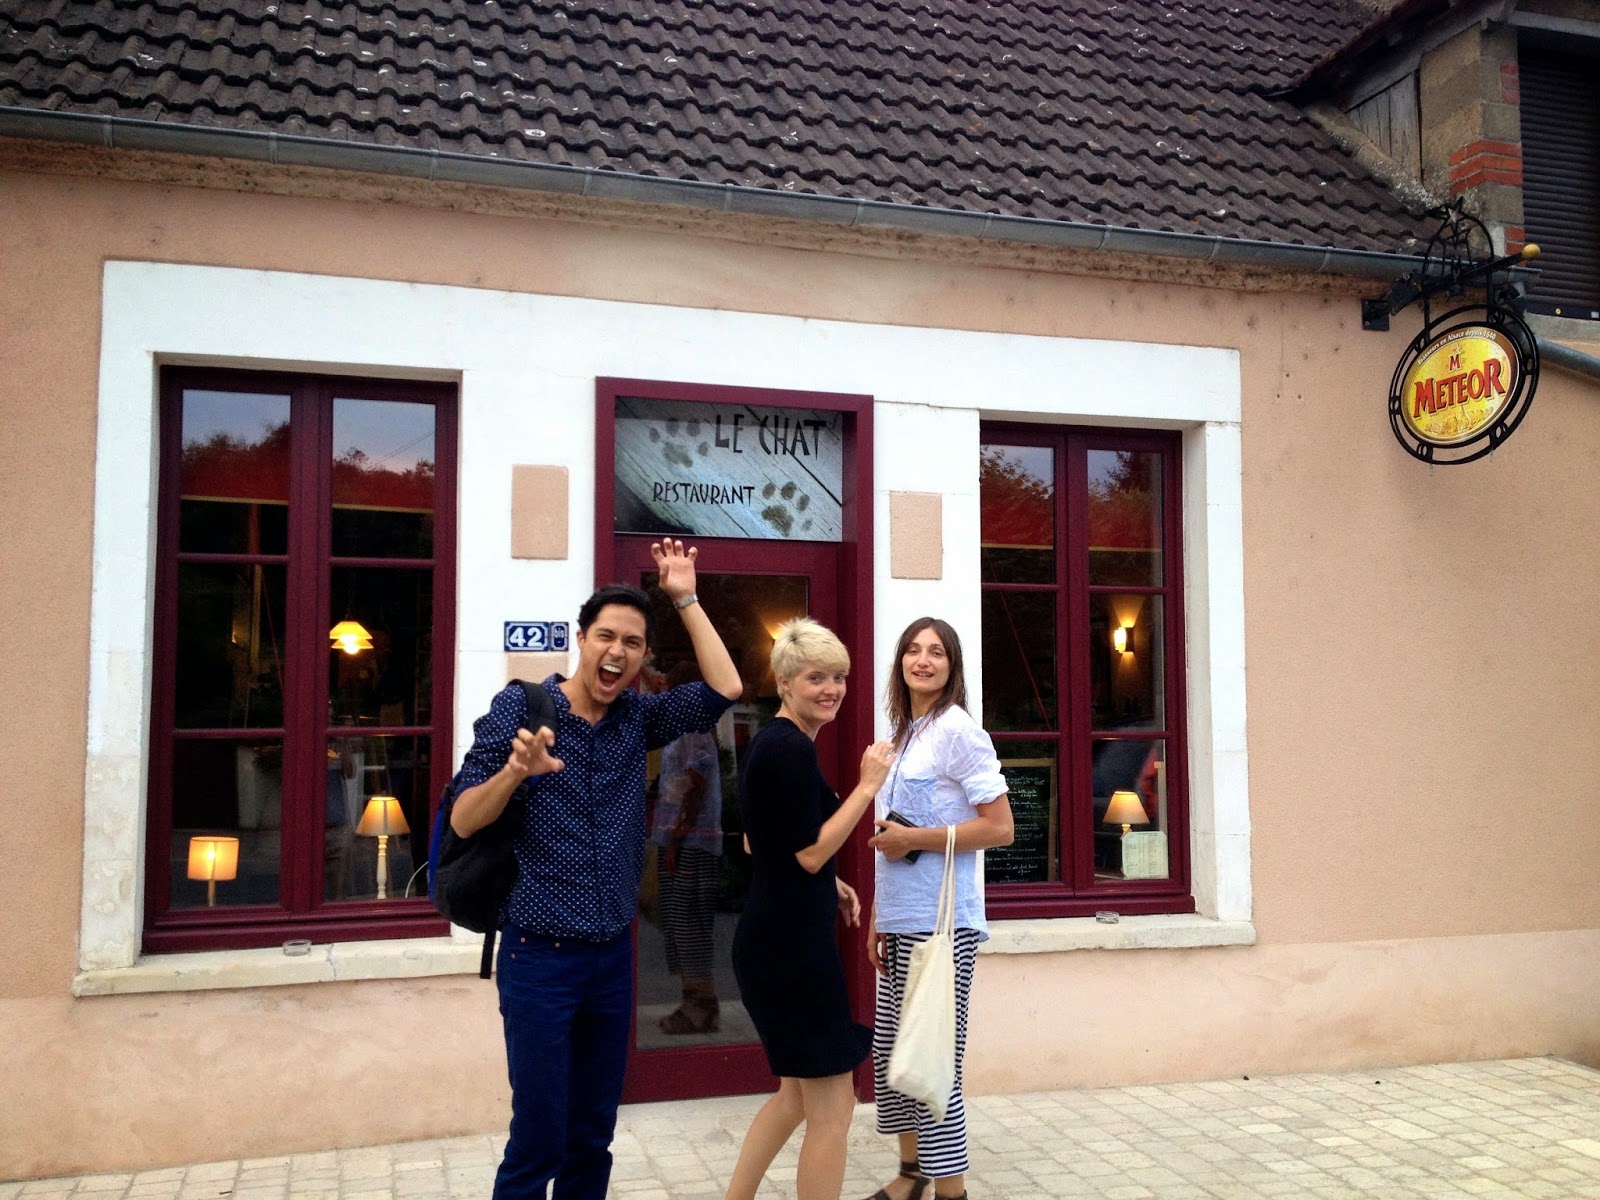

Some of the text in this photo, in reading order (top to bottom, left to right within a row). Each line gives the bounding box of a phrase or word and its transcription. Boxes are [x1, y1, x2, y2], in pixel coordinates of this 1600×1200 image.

[1447, 331, 1464, 341] Alsace
[1465, 329, 1482, 338] depuis
[1413, 358, 1506, 418] METEOR
[715, 413, 827, 461] LE CHAT
[653, 481, 755, 506] RESTAURANT
[509, 627, 543, 647] 42
